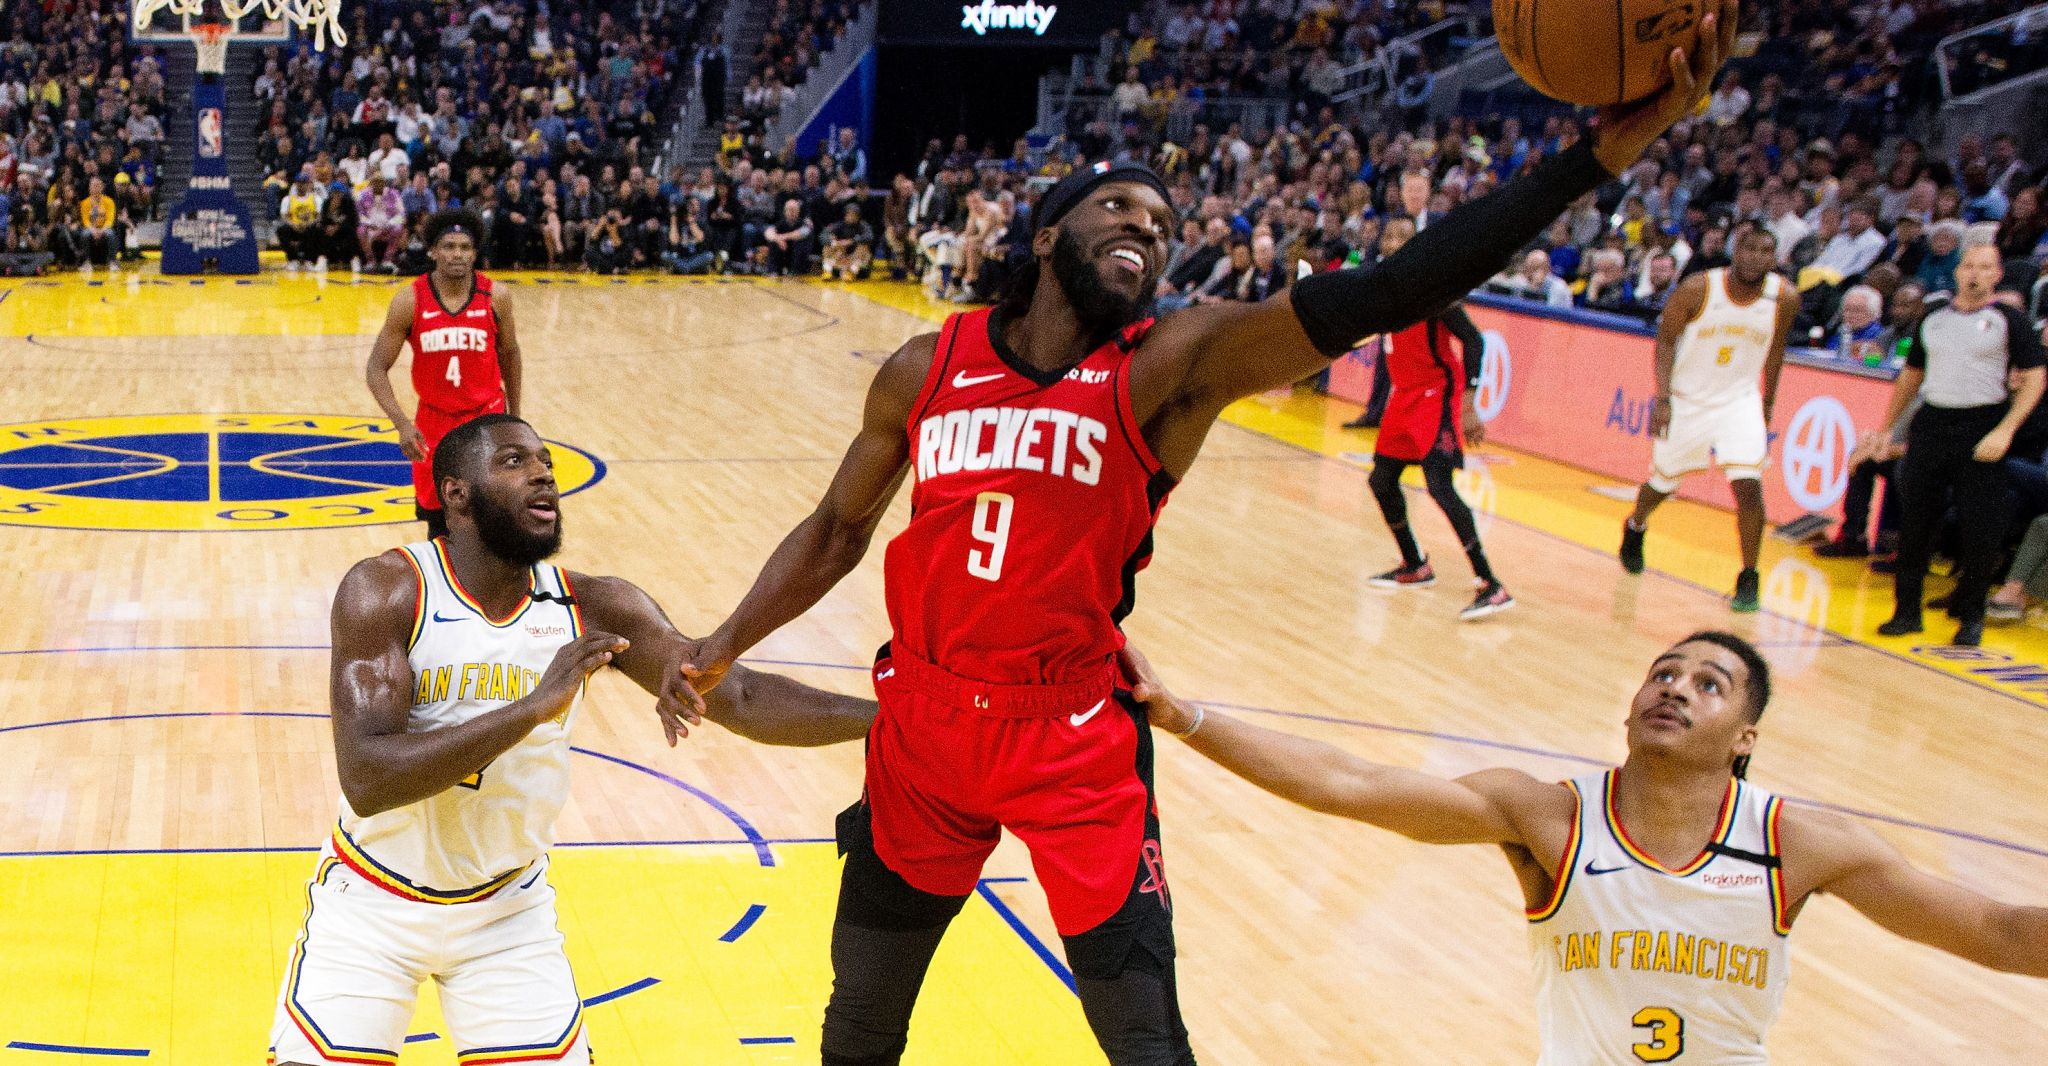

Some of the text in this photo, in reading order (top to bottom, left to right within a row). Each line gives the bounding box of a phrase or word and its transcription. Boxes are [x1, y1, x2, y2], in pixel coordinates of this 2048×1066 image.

[961, 0, 1058, 35] xfinity
[420, 326, 488, 354] ROCKETS
[445, 355, 461, 388] 4
[918, 407, 1107, 486] ROCKETS
[967, 491, 1014, 582] 9
[415, 664, 453, 705] AN
[1703, 873, 1763, 888] Rakuten
[1610, 929, 1770, 990] FRANCISCO
[1632, 1005, 1685, 1063] 3
